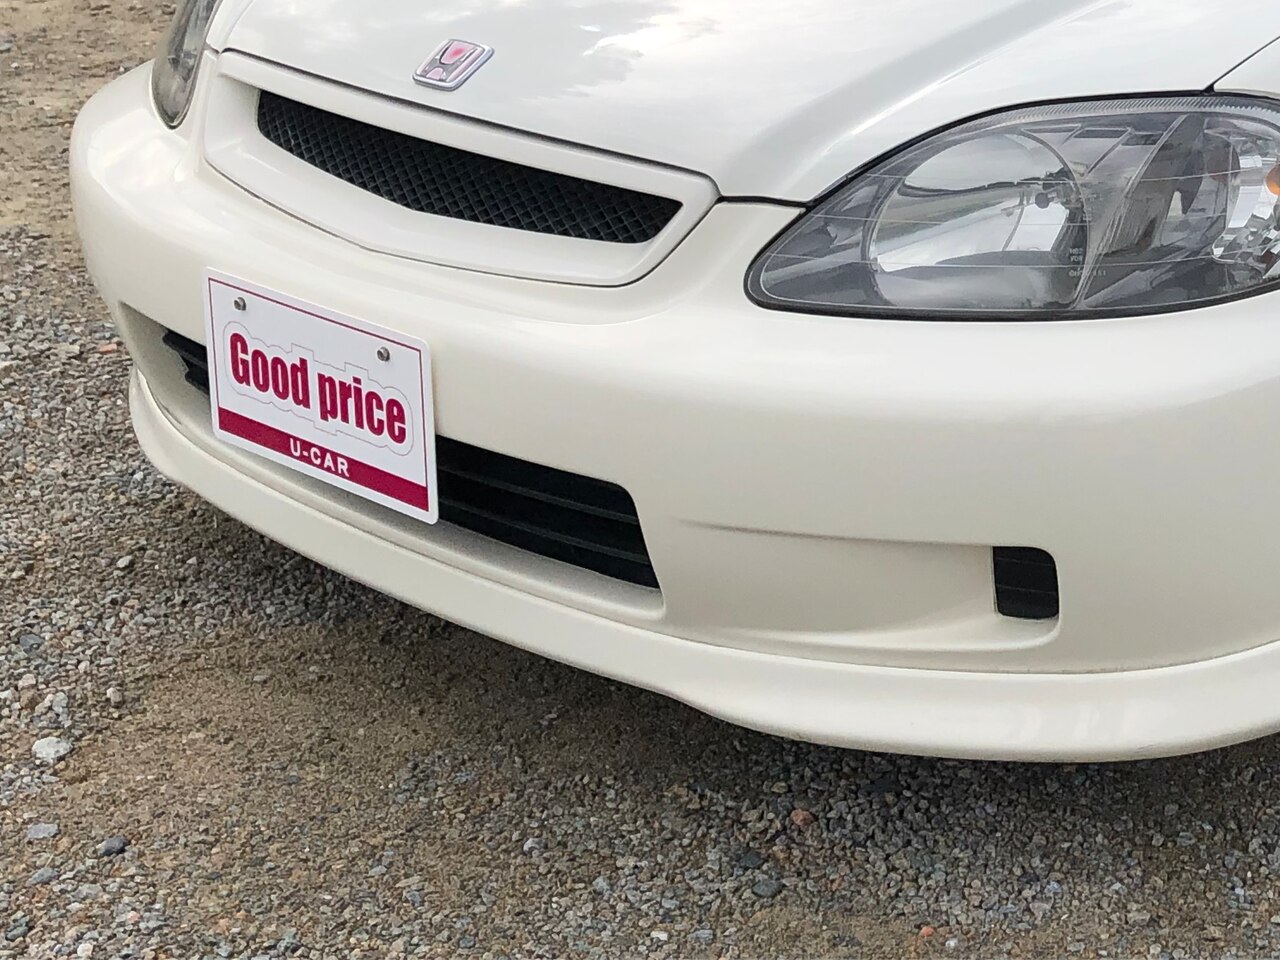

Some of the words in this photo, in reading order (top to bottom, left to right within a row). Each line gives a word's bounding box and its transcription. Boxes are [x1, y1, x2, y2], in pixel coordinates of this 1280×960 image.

[229, 332, 310, 409] Good
[317, 372, 406, 444] price
[290, 437, 349, 477] U-CAR
